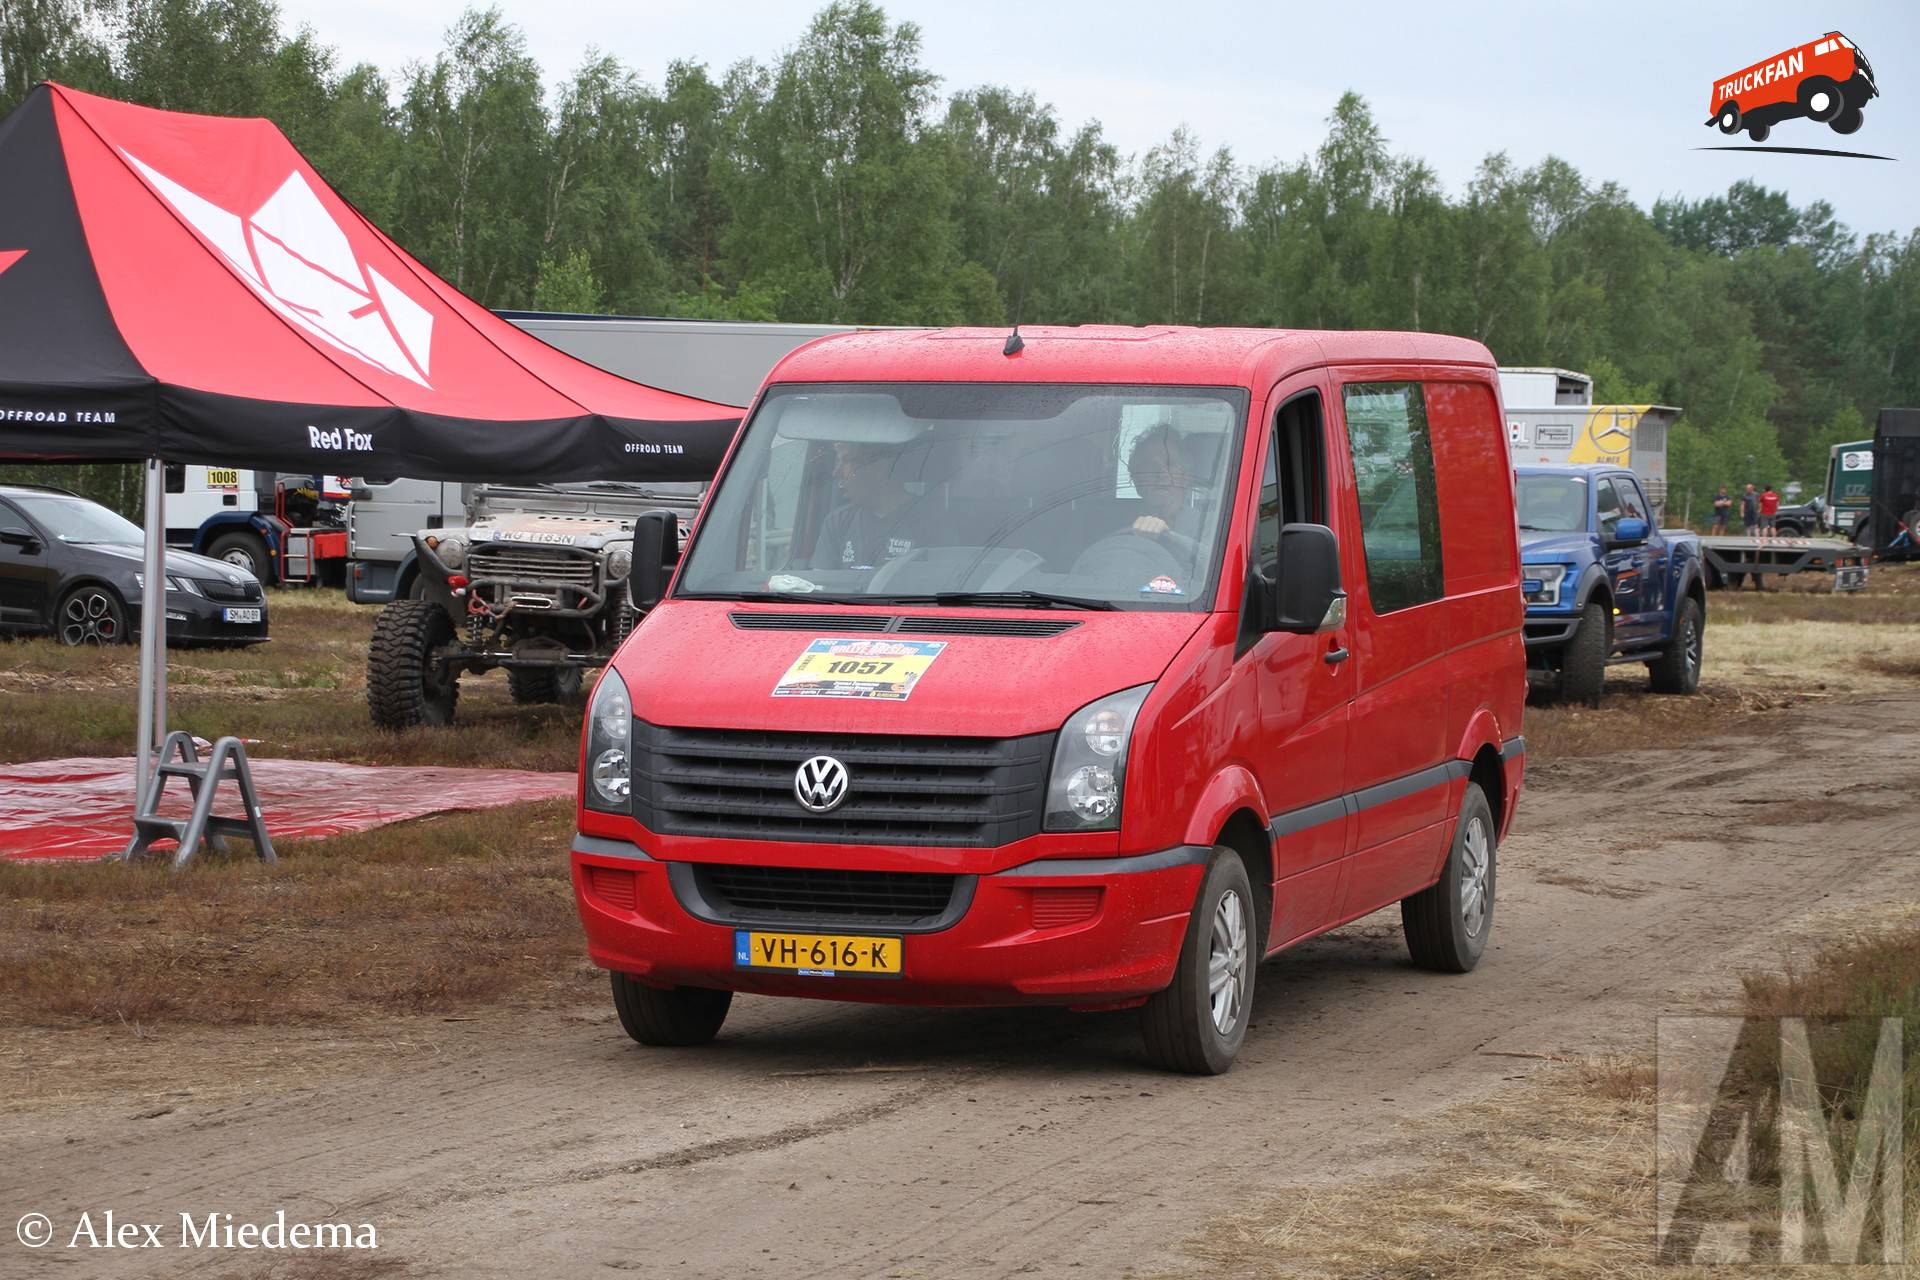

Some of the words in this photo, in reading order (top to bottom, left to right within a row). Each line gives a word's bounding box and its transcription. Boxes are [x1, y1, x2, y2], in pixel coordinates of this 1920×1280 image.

[76, 412, 116, 423] TEAM
[308, 425, 342, 450] Red
[343, 428, 373, 451] Fox
[624, 443, 661, 454] OFFROAD
[664, 444, 684, 454] TEAM
[211, 470, 237, 484] 1008
[826, 660, 894, 675] 1057
[795, 755, 849, 812] VW
[738, 951, 749, 961] NL
[761, 937, 888, 968] VH-616-K
